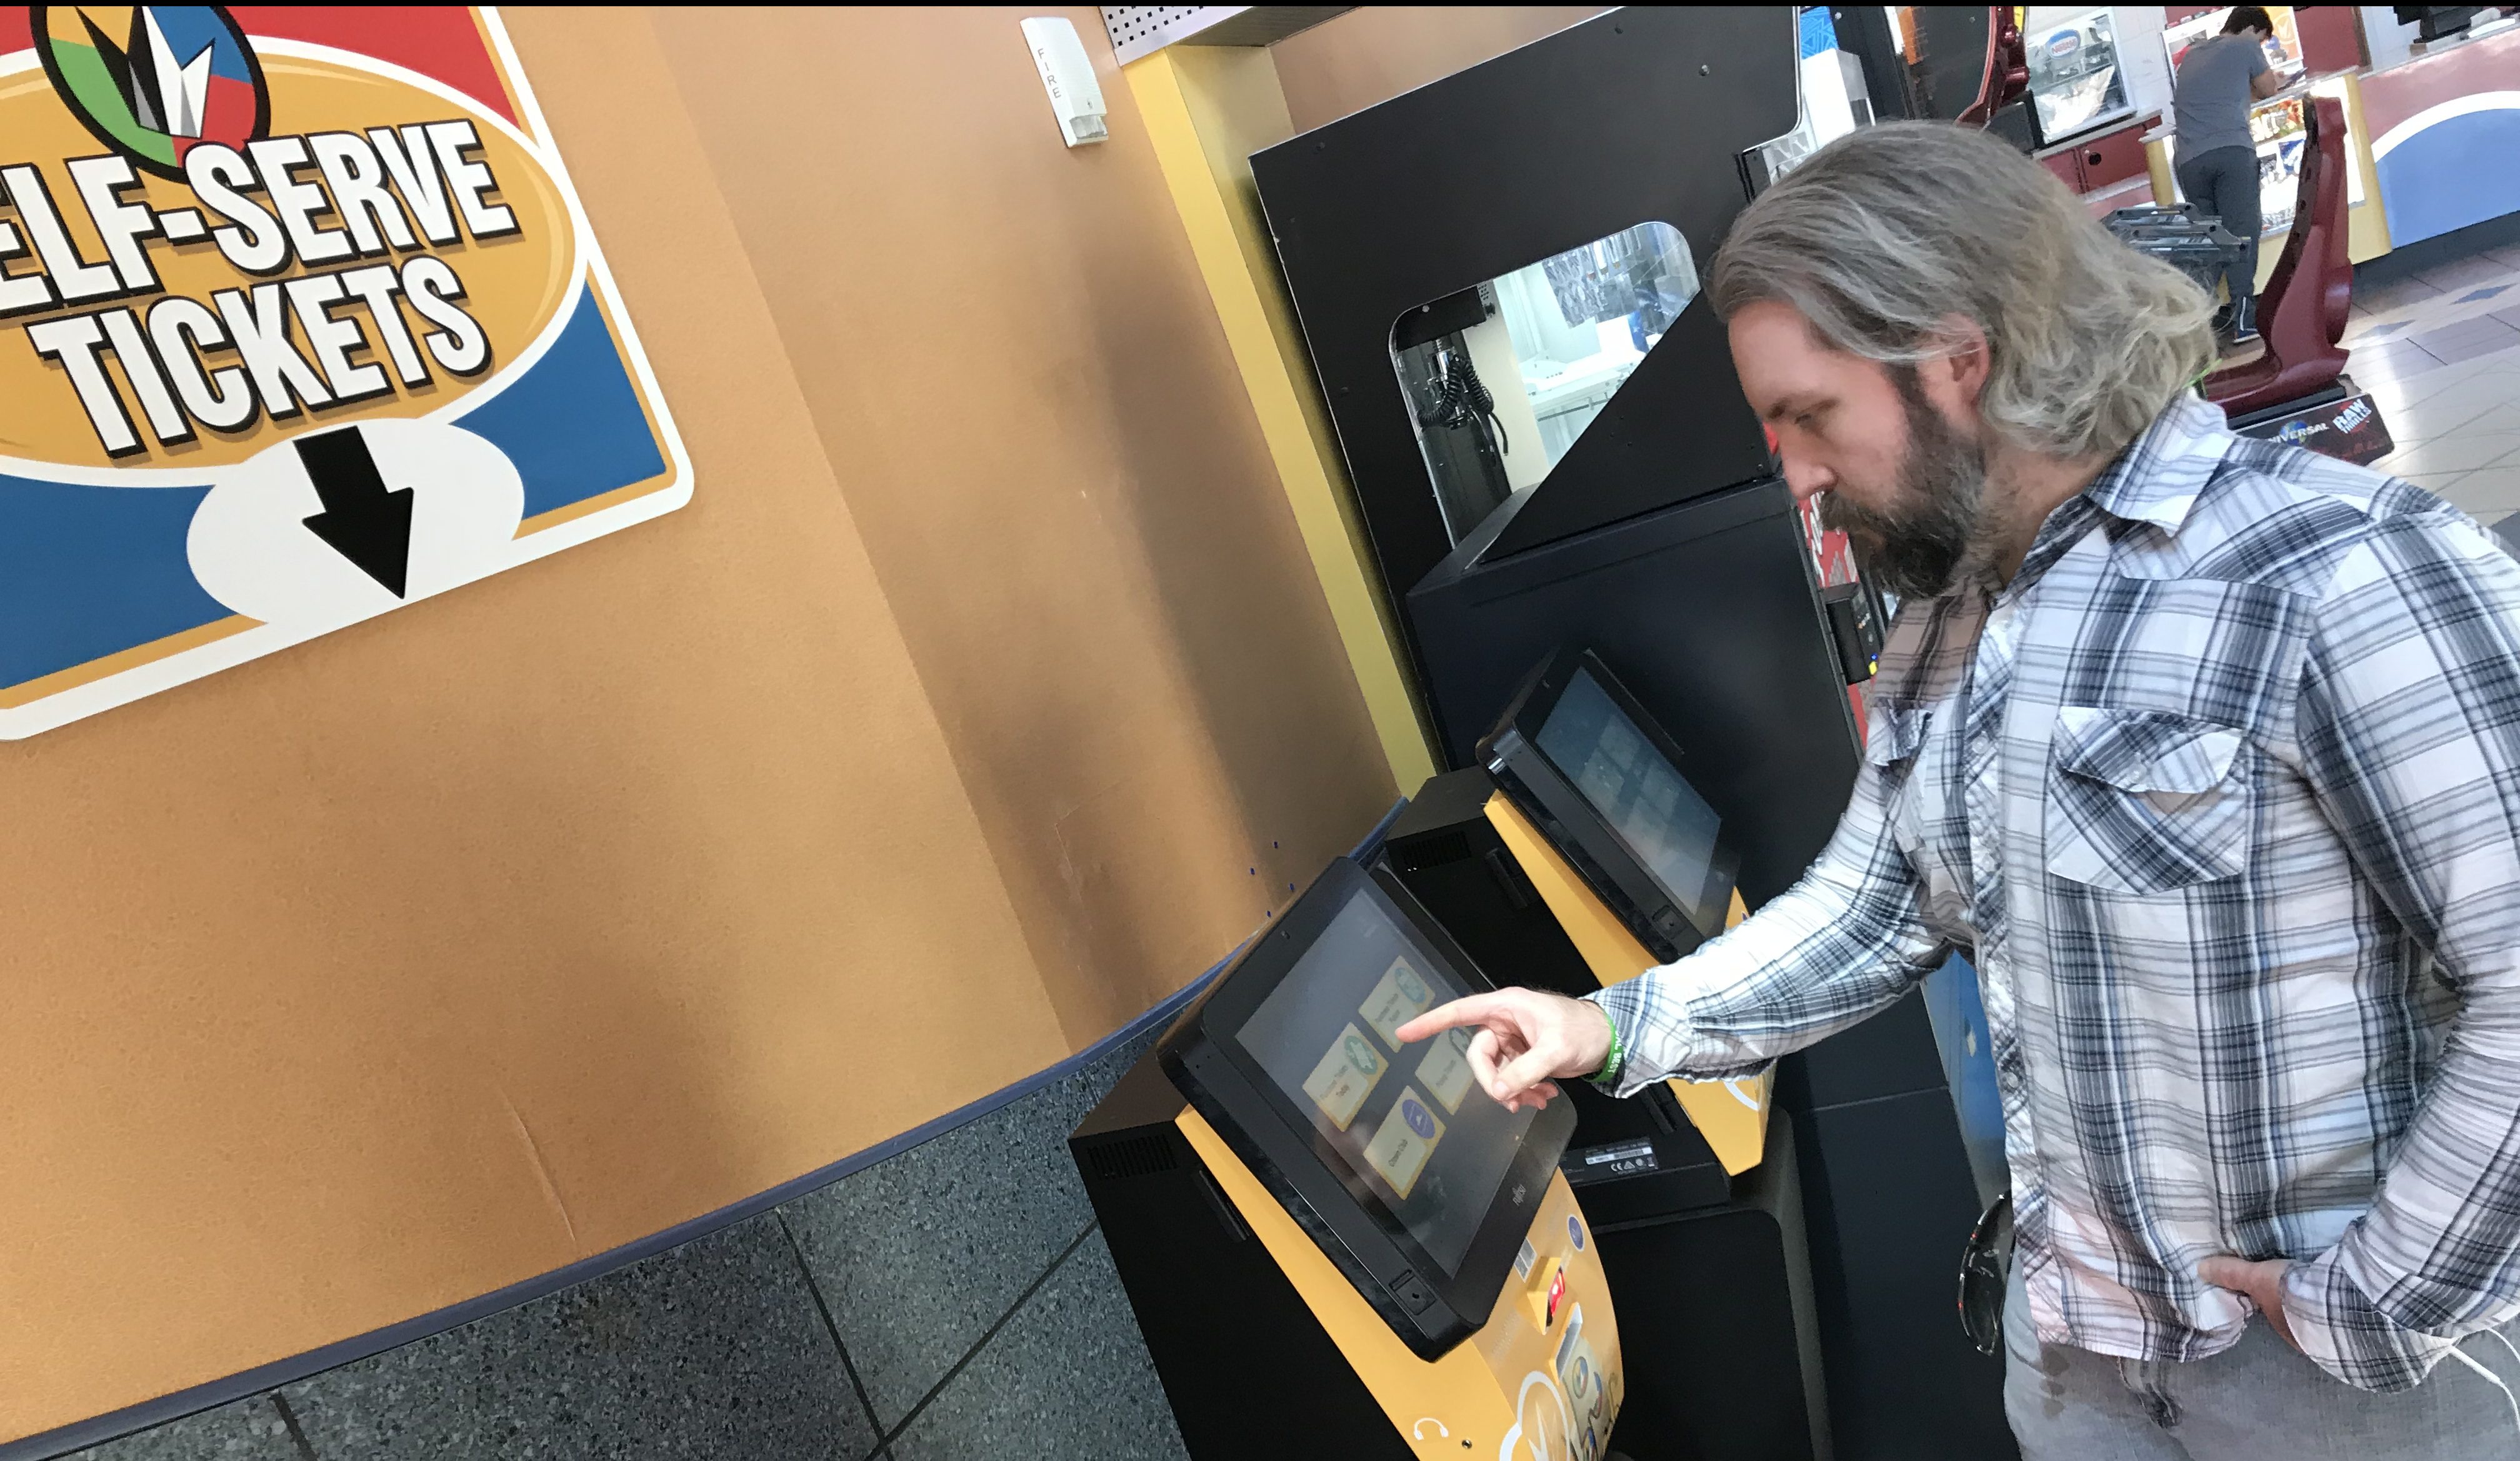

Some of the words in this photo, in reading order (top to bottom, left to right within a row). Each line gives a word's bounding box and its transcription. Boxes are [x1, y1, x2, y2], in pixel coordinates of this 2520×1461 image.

[1038, 47, 1062, 99] FIRE
[24, 255, 491, 459] TICKETS
[2332, 399, 2366, 431] RAW
[2268, 423, 2329, 444] NIVERSAL
[1608, 1052, 1622, 1074] BEST
